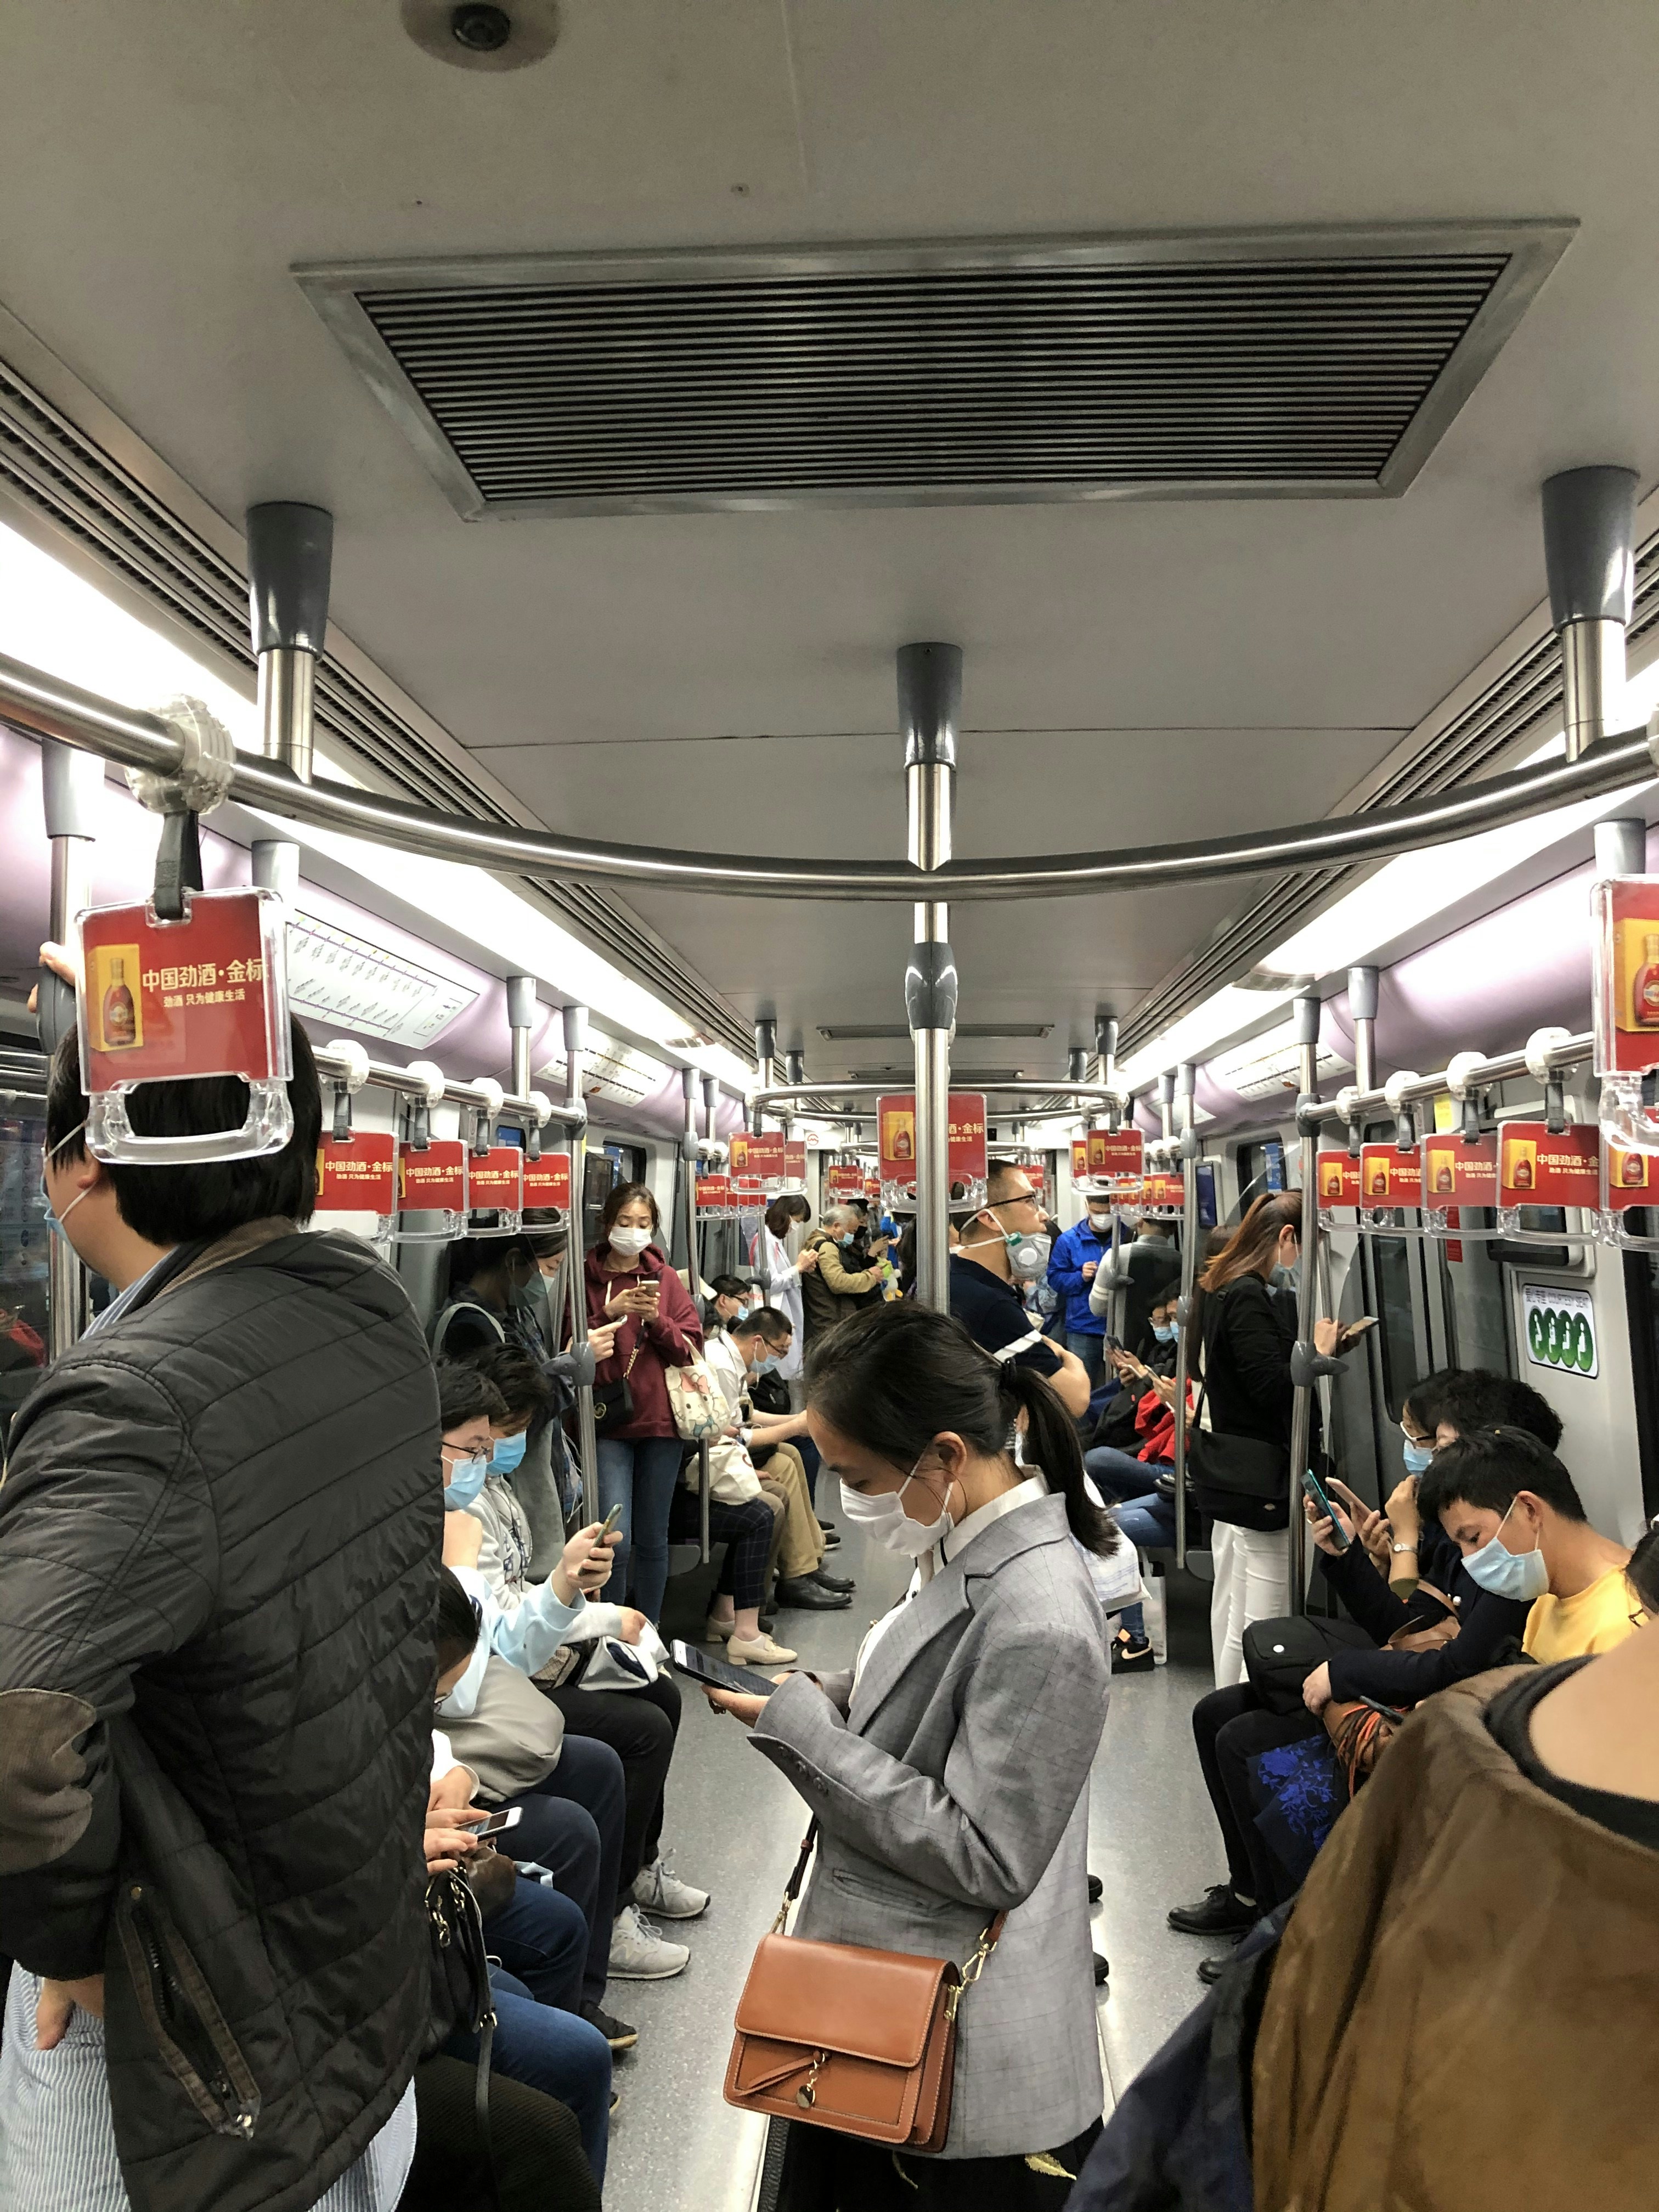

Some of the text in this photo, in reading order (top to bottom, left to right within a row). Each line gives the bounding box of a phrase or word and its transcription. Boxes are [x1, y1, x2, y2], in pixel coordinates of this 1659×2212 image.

[142, 958, 263, 992] 中国劲酒·金标
[163, 988, 246, 1008] 劲酒 只为健康生活
[325, 1161, 393, 1172] 中国劲酒·金标
